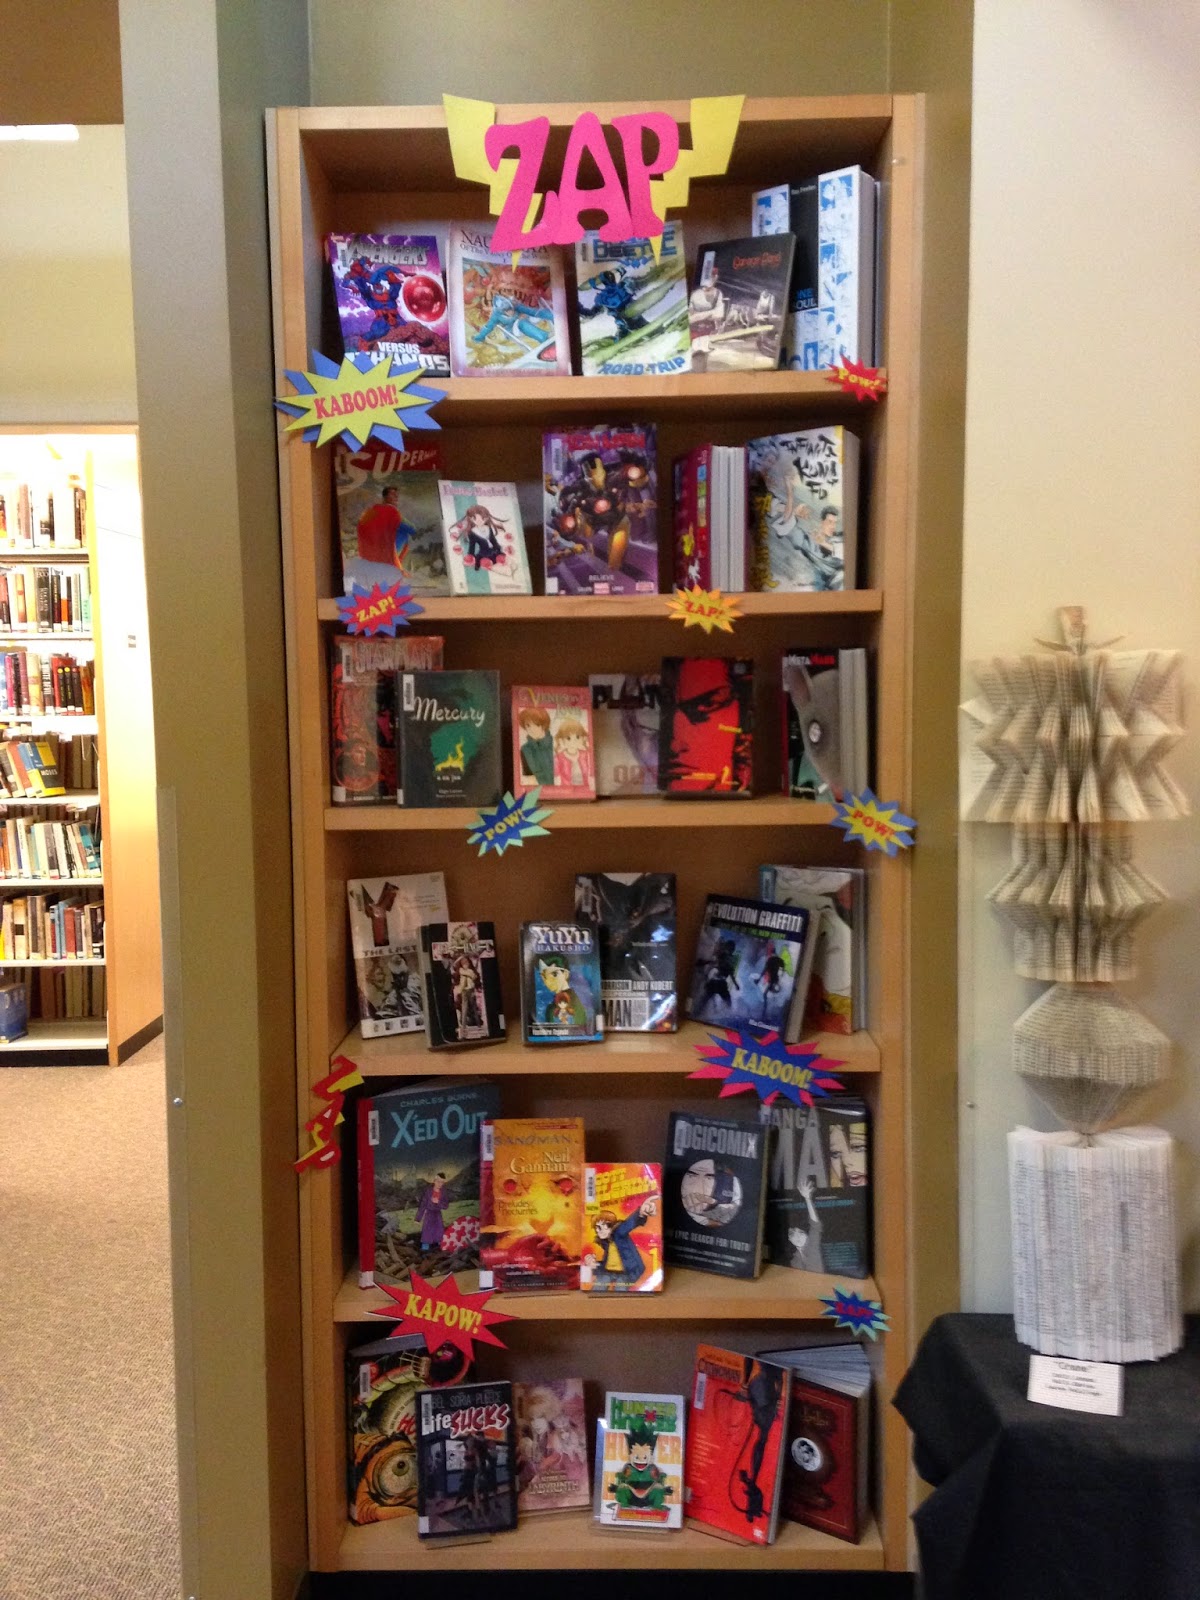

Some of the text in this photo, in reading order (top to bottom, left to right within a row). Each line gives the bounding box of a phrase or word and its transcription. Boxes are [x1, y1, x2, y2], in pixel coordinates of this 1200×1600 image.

[485, 111, 679, 253] ZAP
[377, 341, 421, 354] VERSUS
[598, 356, 686, 375] ROAD TRIP
[314, 384, 399, 419] KABOOM!
[356, 595, 397, 623] ZAP!
[684, 600, 725, 619] ZAP!
[409, 696, 486, 727] Mercury
[484, 808, 527, 841] POW!
[852, 809, 895, 841] POW!
[759, 909, 804, 933] GRAFFITI
[731, 1047, 813, 1090] KABOOM!
[400, 1098, 445, 1108] CHARLES
[509, 1157, 568, 1175] Gaiman
[542, 1147, 570, 1164] Neil
[404, 1293, 483, 1335] KAPOW!
[450, 1403, 511, 1439] SUCKS
[528, 1480, 580, 1495] LABYRINTH
